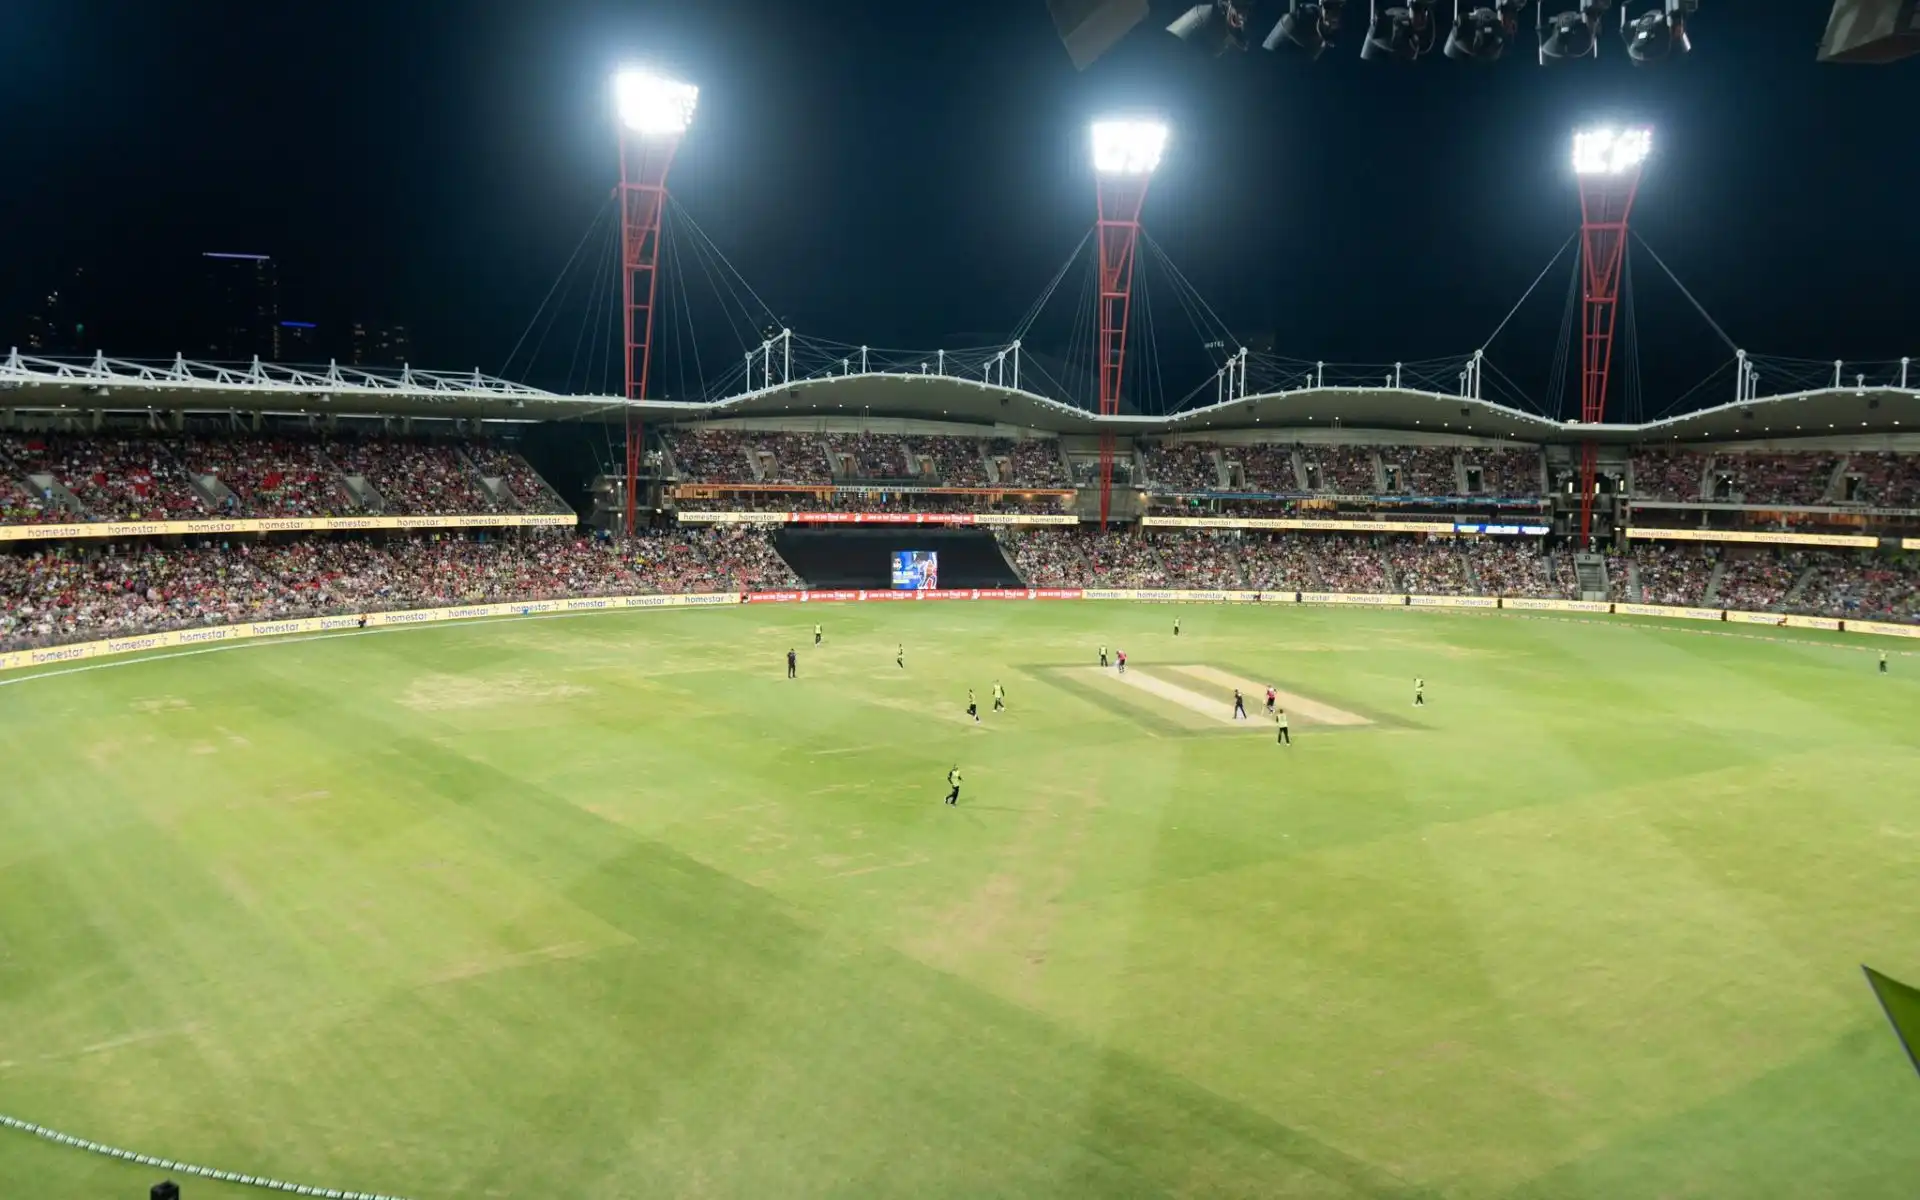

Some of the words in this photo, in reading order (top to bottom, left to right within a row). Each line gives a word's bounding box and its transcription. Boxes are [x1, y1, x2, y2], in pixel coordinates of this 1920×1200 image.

[28, 527, 80, 537] homestar
[108, 524, 157, 533] homestar
[188, 523, 235, 531] homestar
[259, 521, 303, 529] homestar
[327, 519, 371, 528] homestar
[460, 517, 500, 525] homestar
[978, 515, 1014, 523] homestar
[32, 647, 83, 662] homestar
[109, 638, 156, 651] homestar
[180, 631, 226, 642] homestar
[253, 624, 299, 635] homestar
[385, 613, 427, 622] homestar
[449, 607, 489, 617] homestar
[568, 600, 606, 608] homestar
[685, 595, 724, 603] homestar
